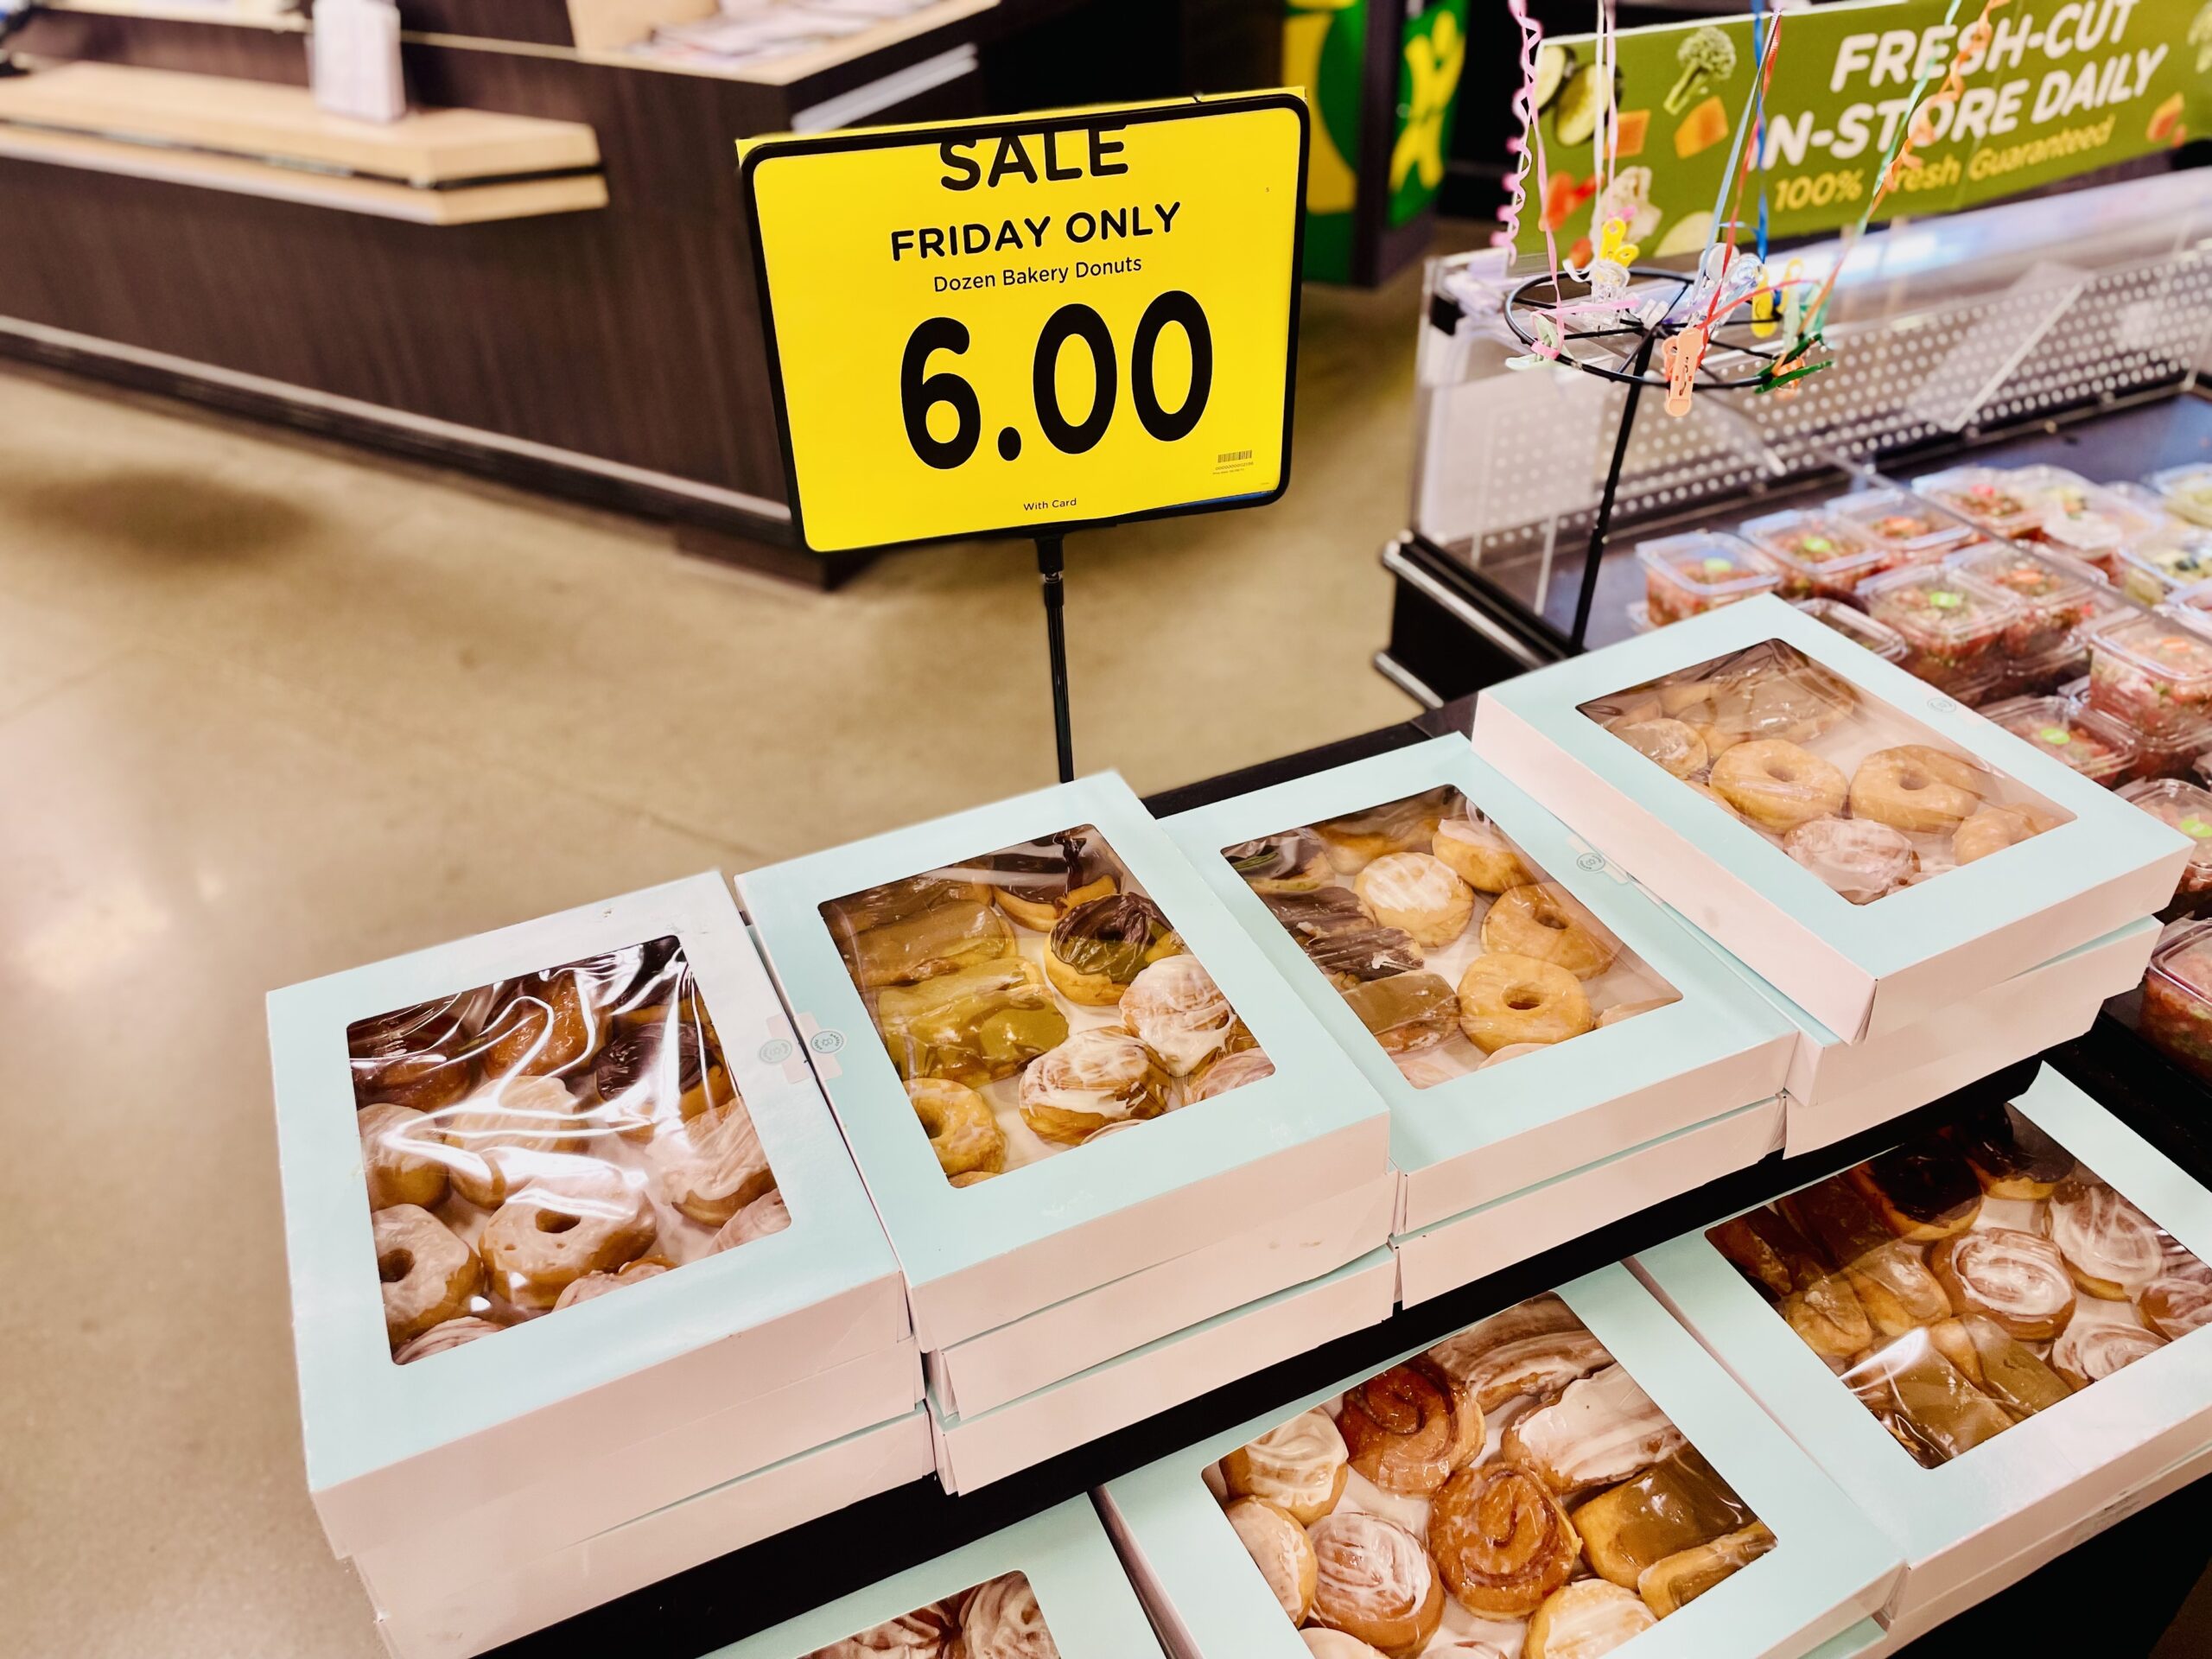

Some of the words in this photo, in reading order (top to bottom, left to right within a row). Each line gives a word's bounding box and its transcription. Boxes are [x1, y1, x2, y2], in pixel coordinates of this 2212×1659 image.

[1829, 0, 2140, 92] FRESH-CUT
[2031, 42, 2169, 124] DAILY
[940, 125, 1128, 191] SALE
[1775, 168, 1865, 212] 100%
[1891, 153, 1961, 192] resh
[1968, 112, 2116, 181] Guaranteed
[891, 215, 1051, 261] FRIDAY
[1065, 201, 1180, 244] ONLY
[934, 275, 995, 293] Dozen
[1002, 266, 1069, 286] Bakery
[1076, 257, 1142, 278] Donuts
[900, 289, 1213, 470] 6.00
[1023, 501, 1049, 512] With
[1052, 497, 1077, 508] Card
